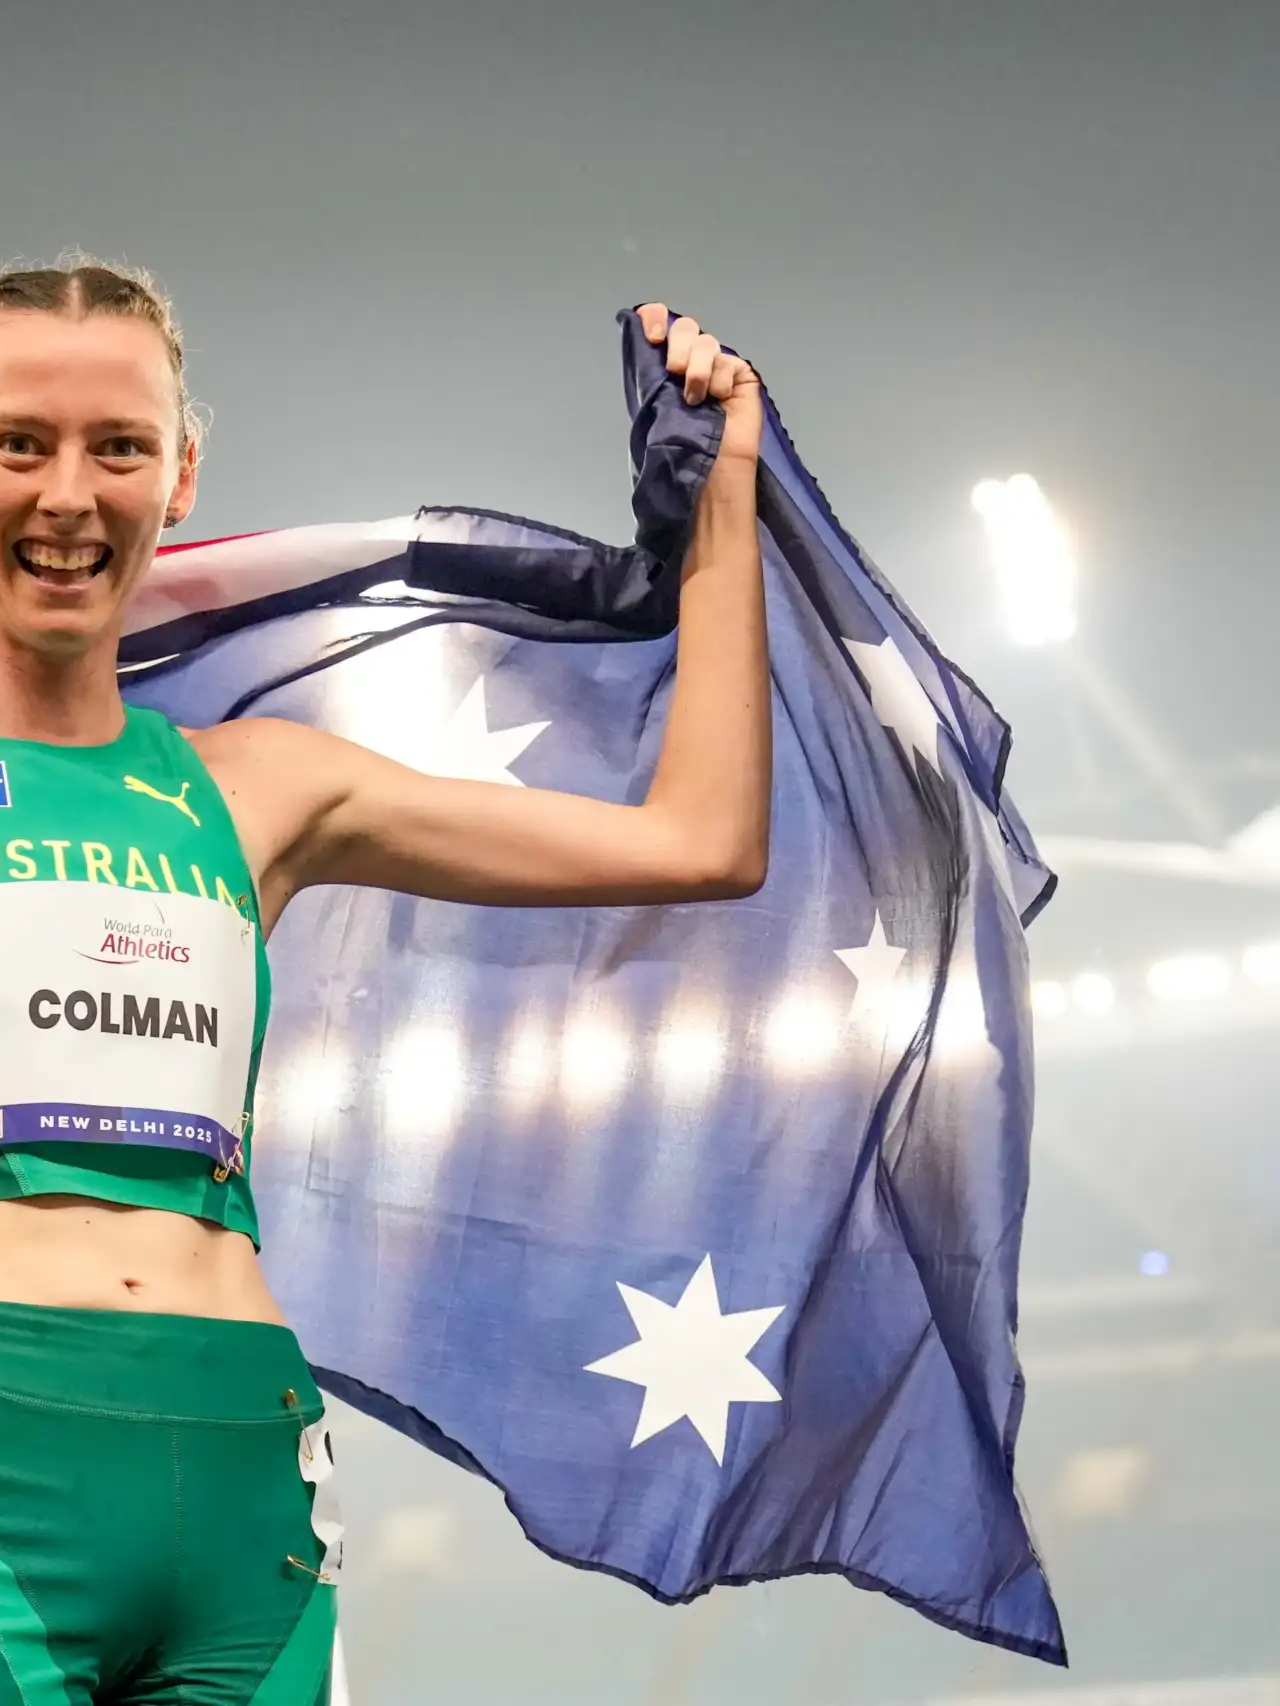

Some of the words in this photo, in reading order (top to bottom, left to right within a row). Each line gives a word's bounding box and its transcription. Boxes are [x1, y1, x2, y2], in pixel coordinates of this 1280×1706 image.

[104, 917, 140, 936] World
[143, 924, 172, 939] Para
[100, 933, 190, 963] Athletics
[28, 988, 218, 1048] COLMAN
[40, 1115, 90, 1130] NEW
[99, 1119, 165, 1135] DELHI
[173, 1124, 212, 1144] 2025
